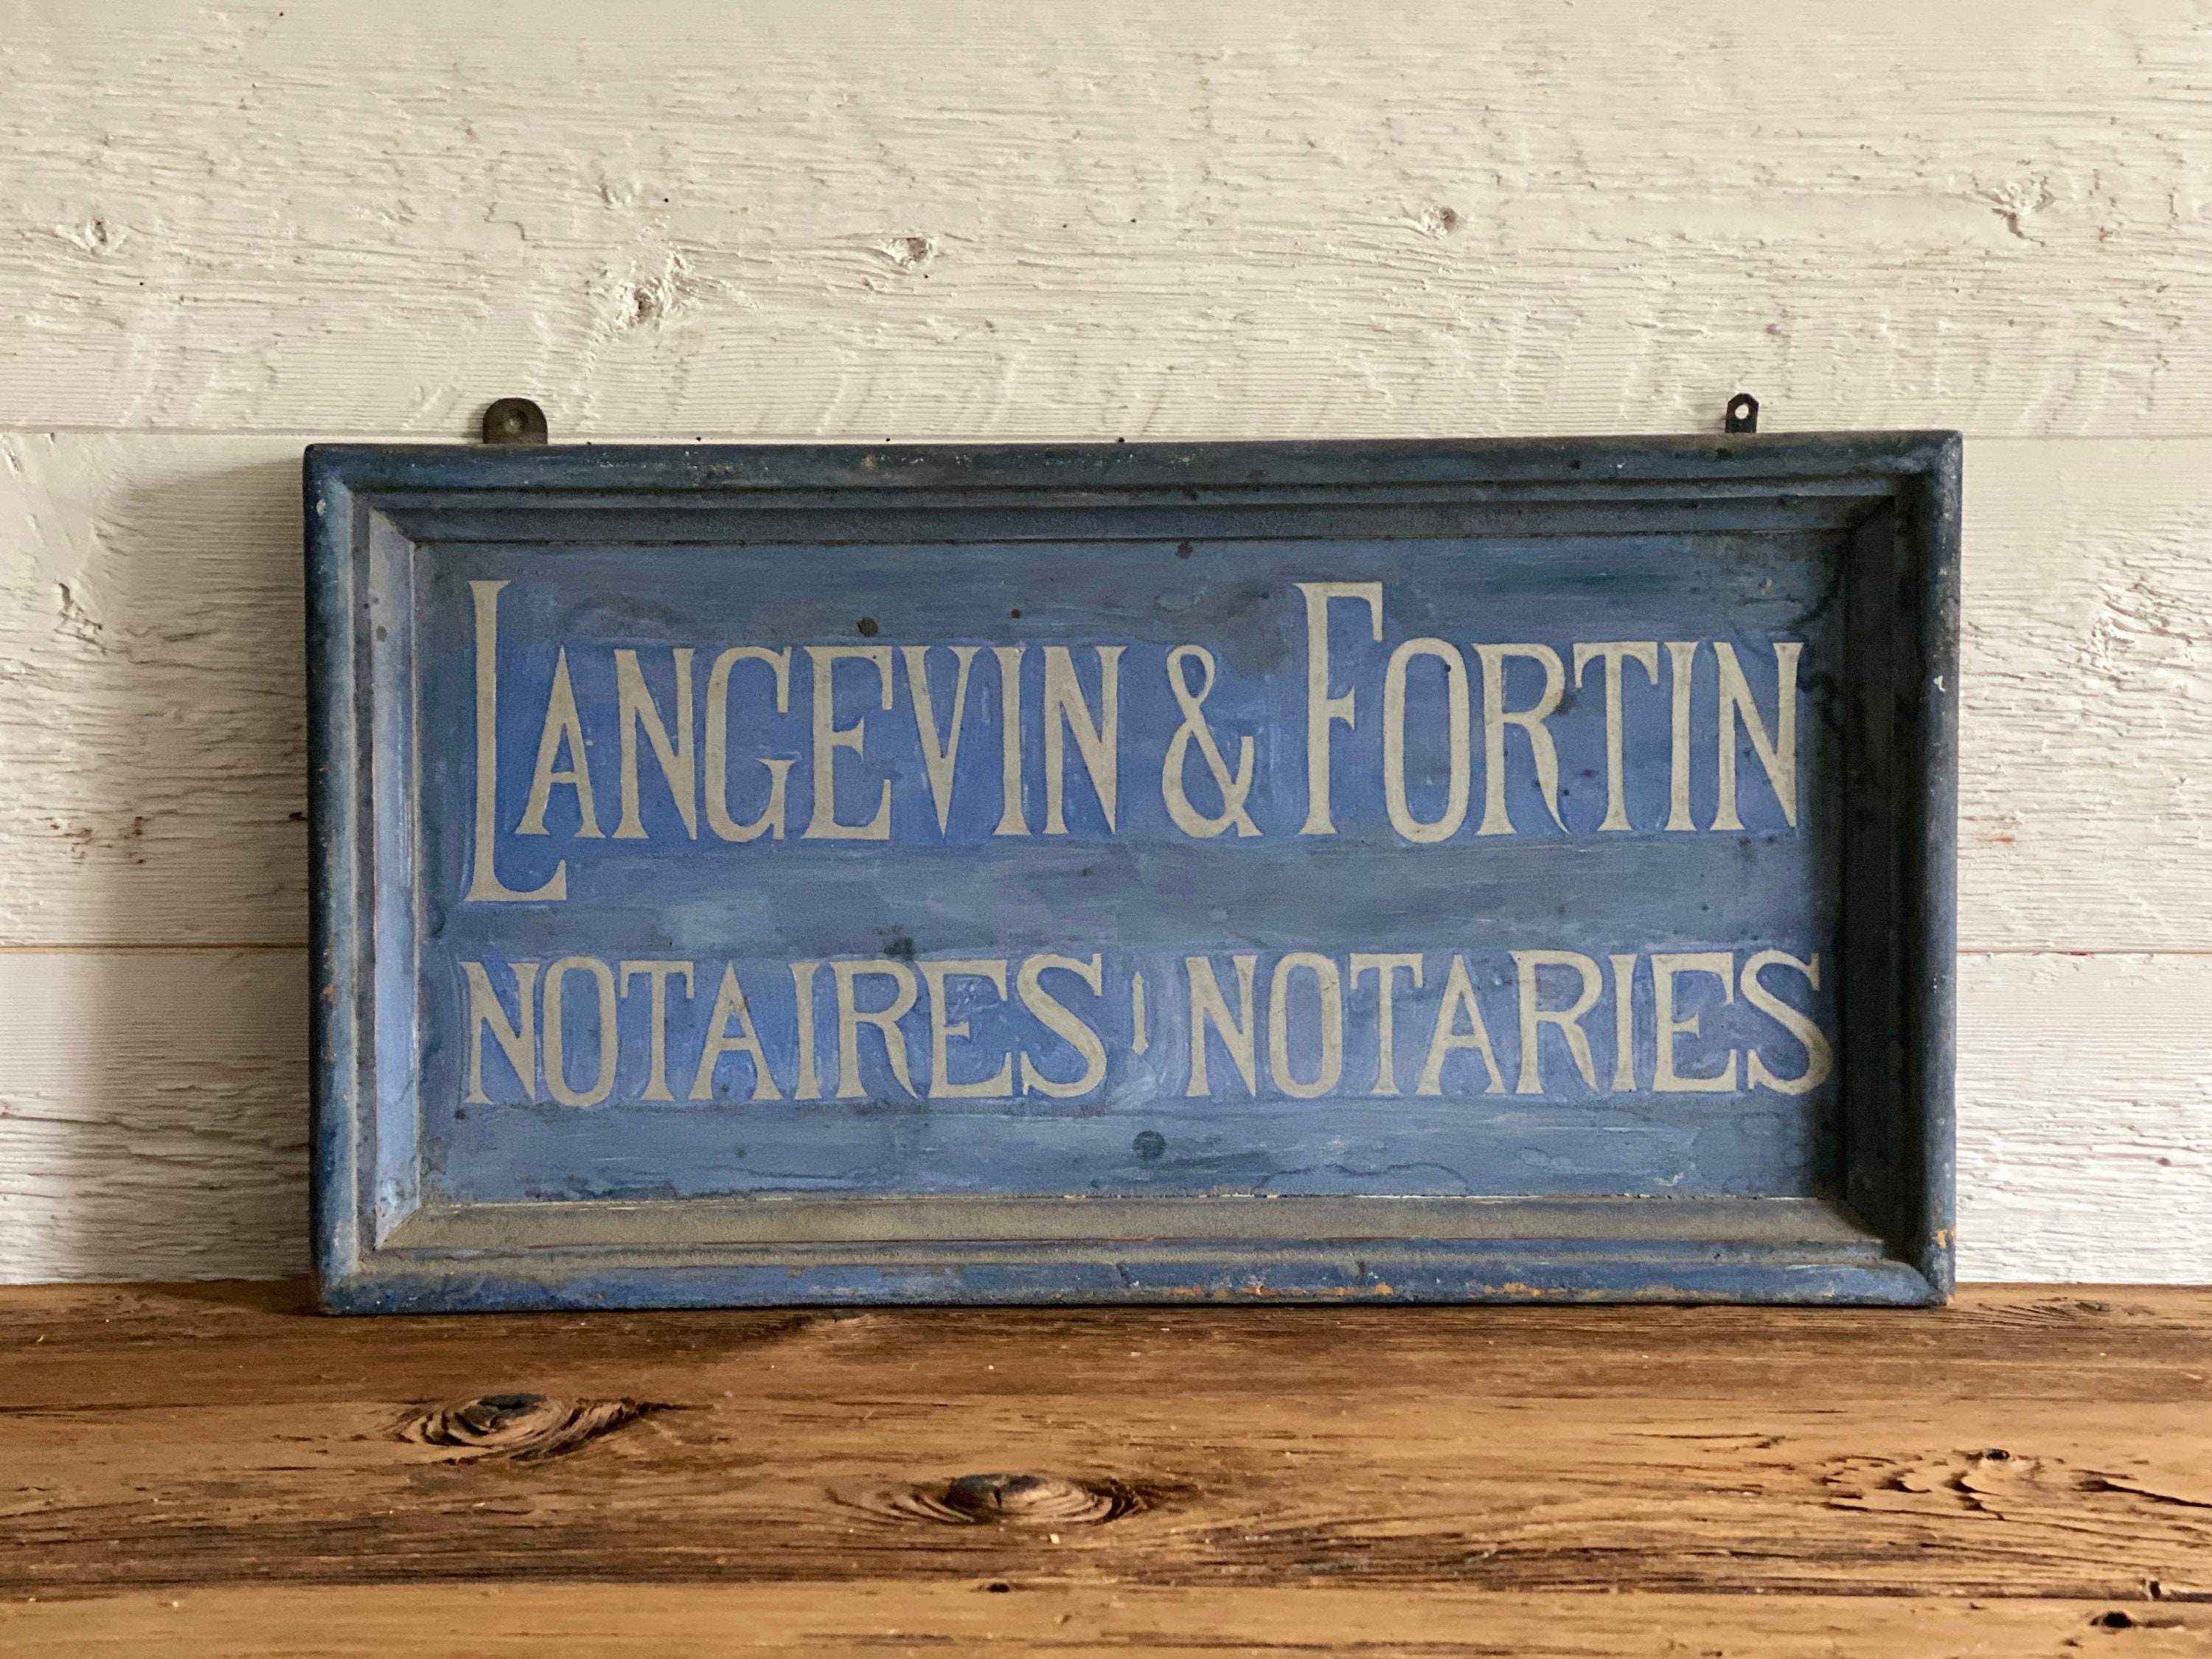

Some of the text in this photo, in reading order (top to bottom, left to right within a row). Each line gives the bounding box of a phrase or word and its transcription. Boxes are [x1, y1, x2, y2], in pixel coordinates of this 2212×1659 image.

[464, 580, 1805, 902] LANGEVIN & FORTIN
[460, 948, 1834, 1107] NOTAIRES NOTARIES
